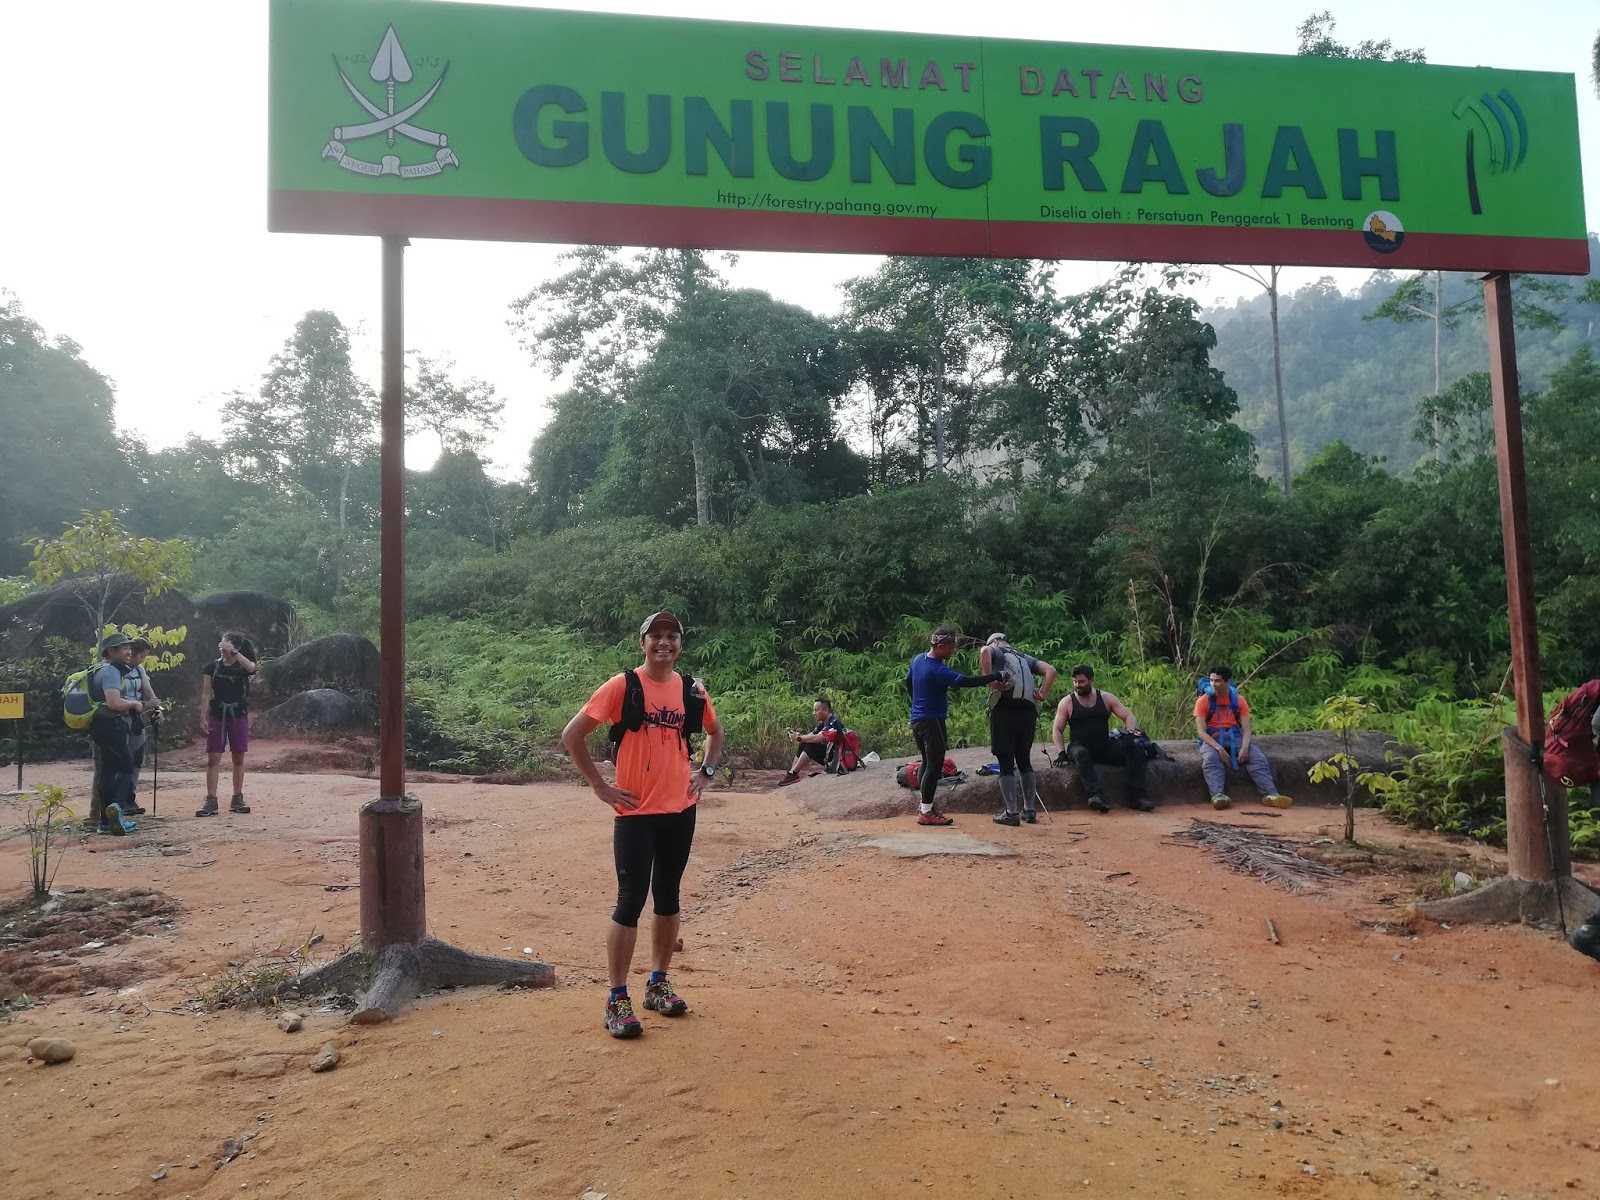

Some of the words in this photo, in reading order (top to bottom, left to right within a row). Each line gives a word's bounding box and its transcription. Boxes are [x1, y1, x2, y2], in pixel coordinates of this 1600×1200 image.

[745, 51, 976, 92] SELAMAT
[1020, 66, 1204, 104] DATANG
[513, 84, 992, 189] GUNUNG
[1040, 115, 1400, 202] RAJAH
[344, 159, 380, 174] NEGERI
[404, 164, 438, 175] PAHANG
[717, 190, 938, 218] http://forestry.pahang.gov.my
[1040, 205, 1087, 219] Diselia
[1091, 207, 1121, 220] oleh
[1137, 208, 1204, 222] Persatuan
[1210, 210, 1281, 227] Penggerak
[1286, 213, 1291, 225] 1
[1301, 213, 1354, 229] Bentong
